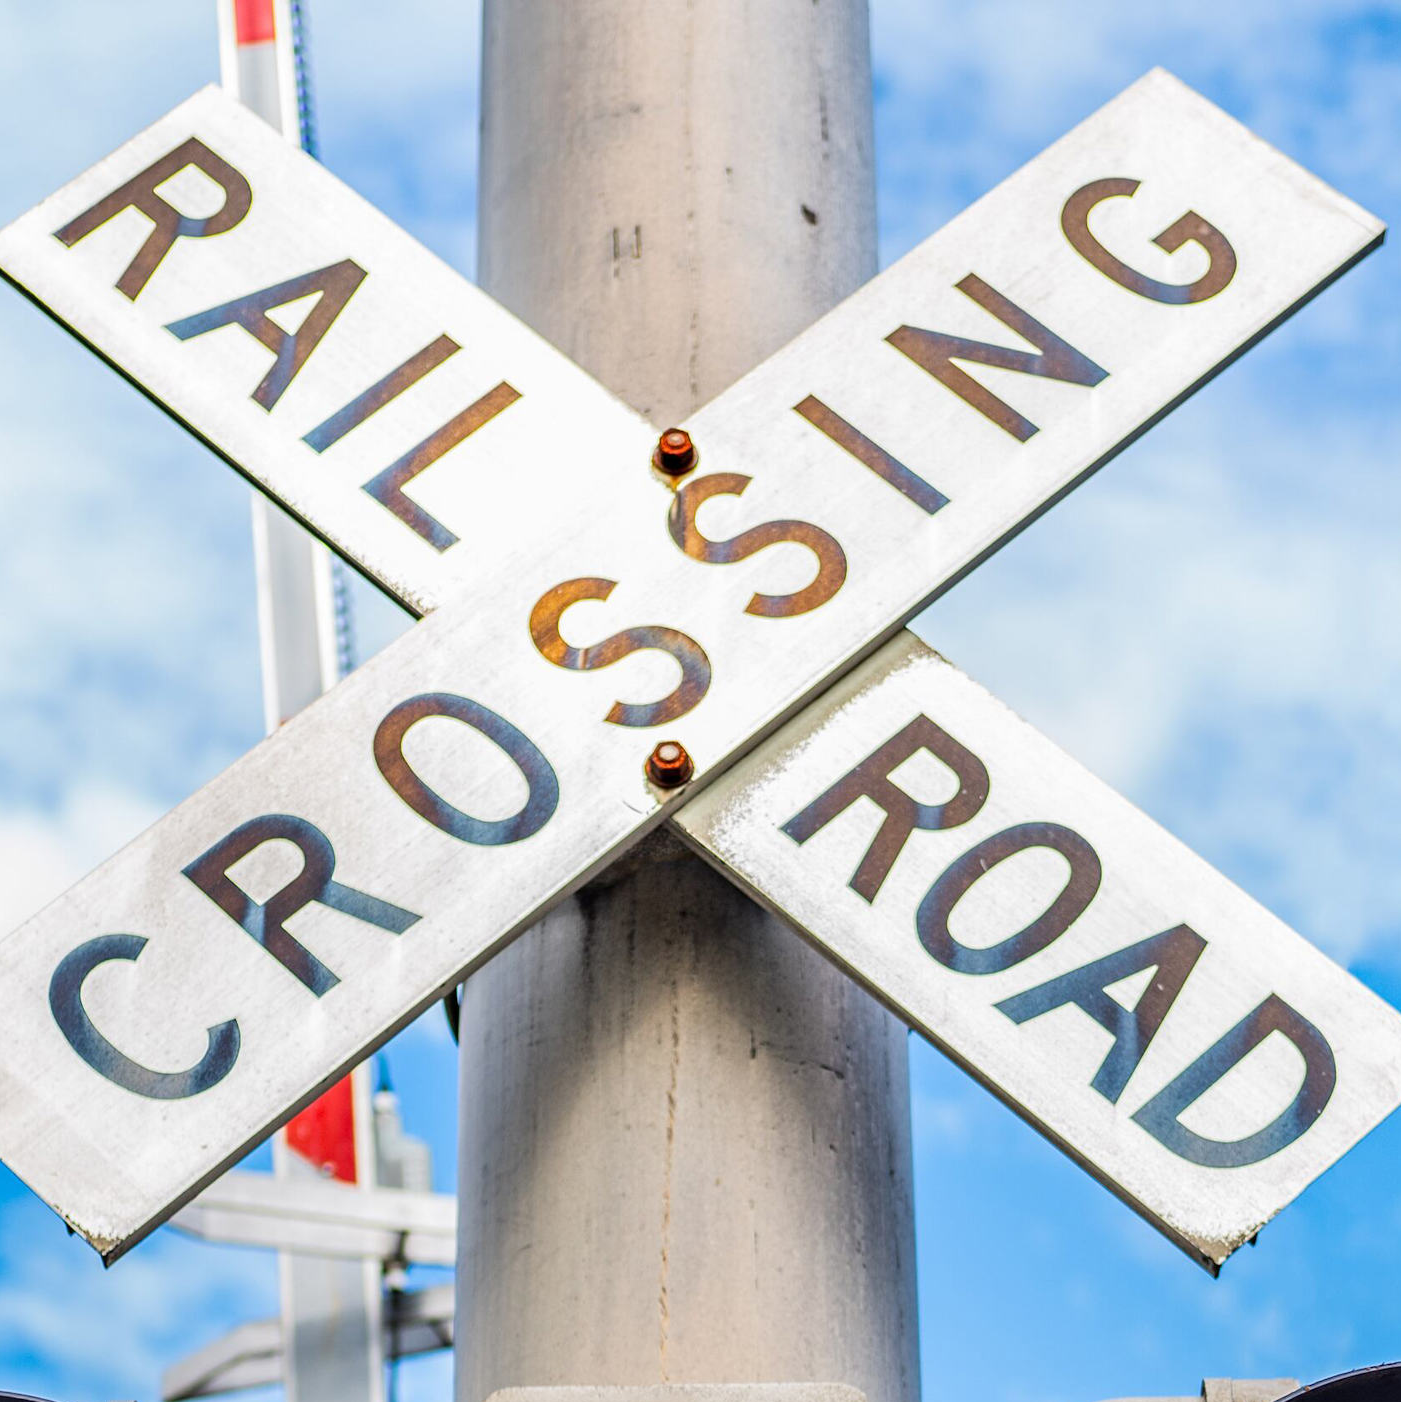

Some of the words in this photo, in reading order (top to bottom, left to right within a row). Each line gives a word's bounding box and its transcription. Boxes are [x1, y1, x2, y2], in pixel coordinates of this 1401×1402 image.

[48, 176, 1238, 1101] CROSSING
[55, 135, 523, 552] RAIL
[781, 713, 1338, 1168] ROAD
